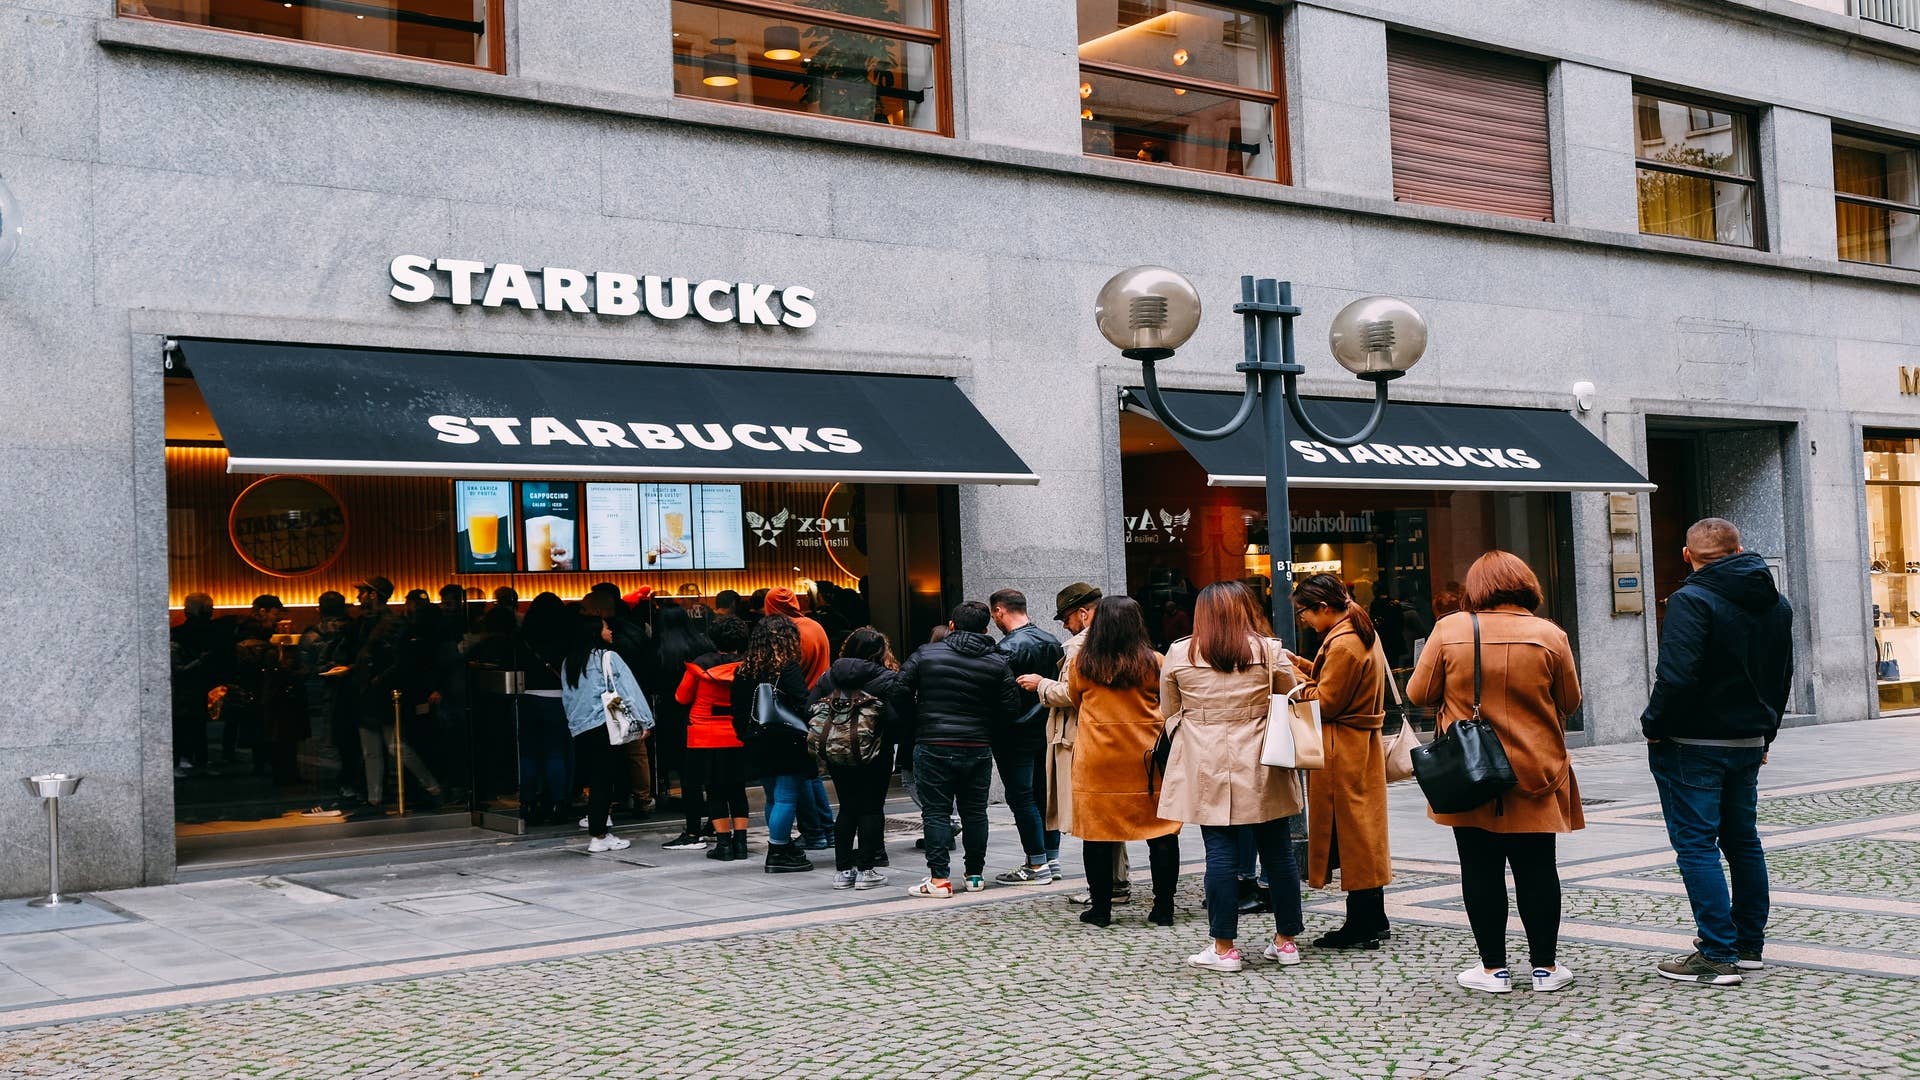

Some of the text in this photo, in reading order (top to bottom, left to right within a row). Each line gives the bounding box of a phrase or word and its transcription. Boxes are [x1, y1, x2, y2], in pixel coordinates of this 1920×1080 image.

[390, 255, 818, 328] STARBUCKS
[428, 415, 863, 454] STARBUCKS
[1289, 440, 1541, 469] STARBUCKS
[1810, 440, 1817, 456] 5
[529, 492, 569, 500] CAPPUCCINO
[1277, 560, 1292, 571] BT
[1286, 571, 1292, 582] 9
